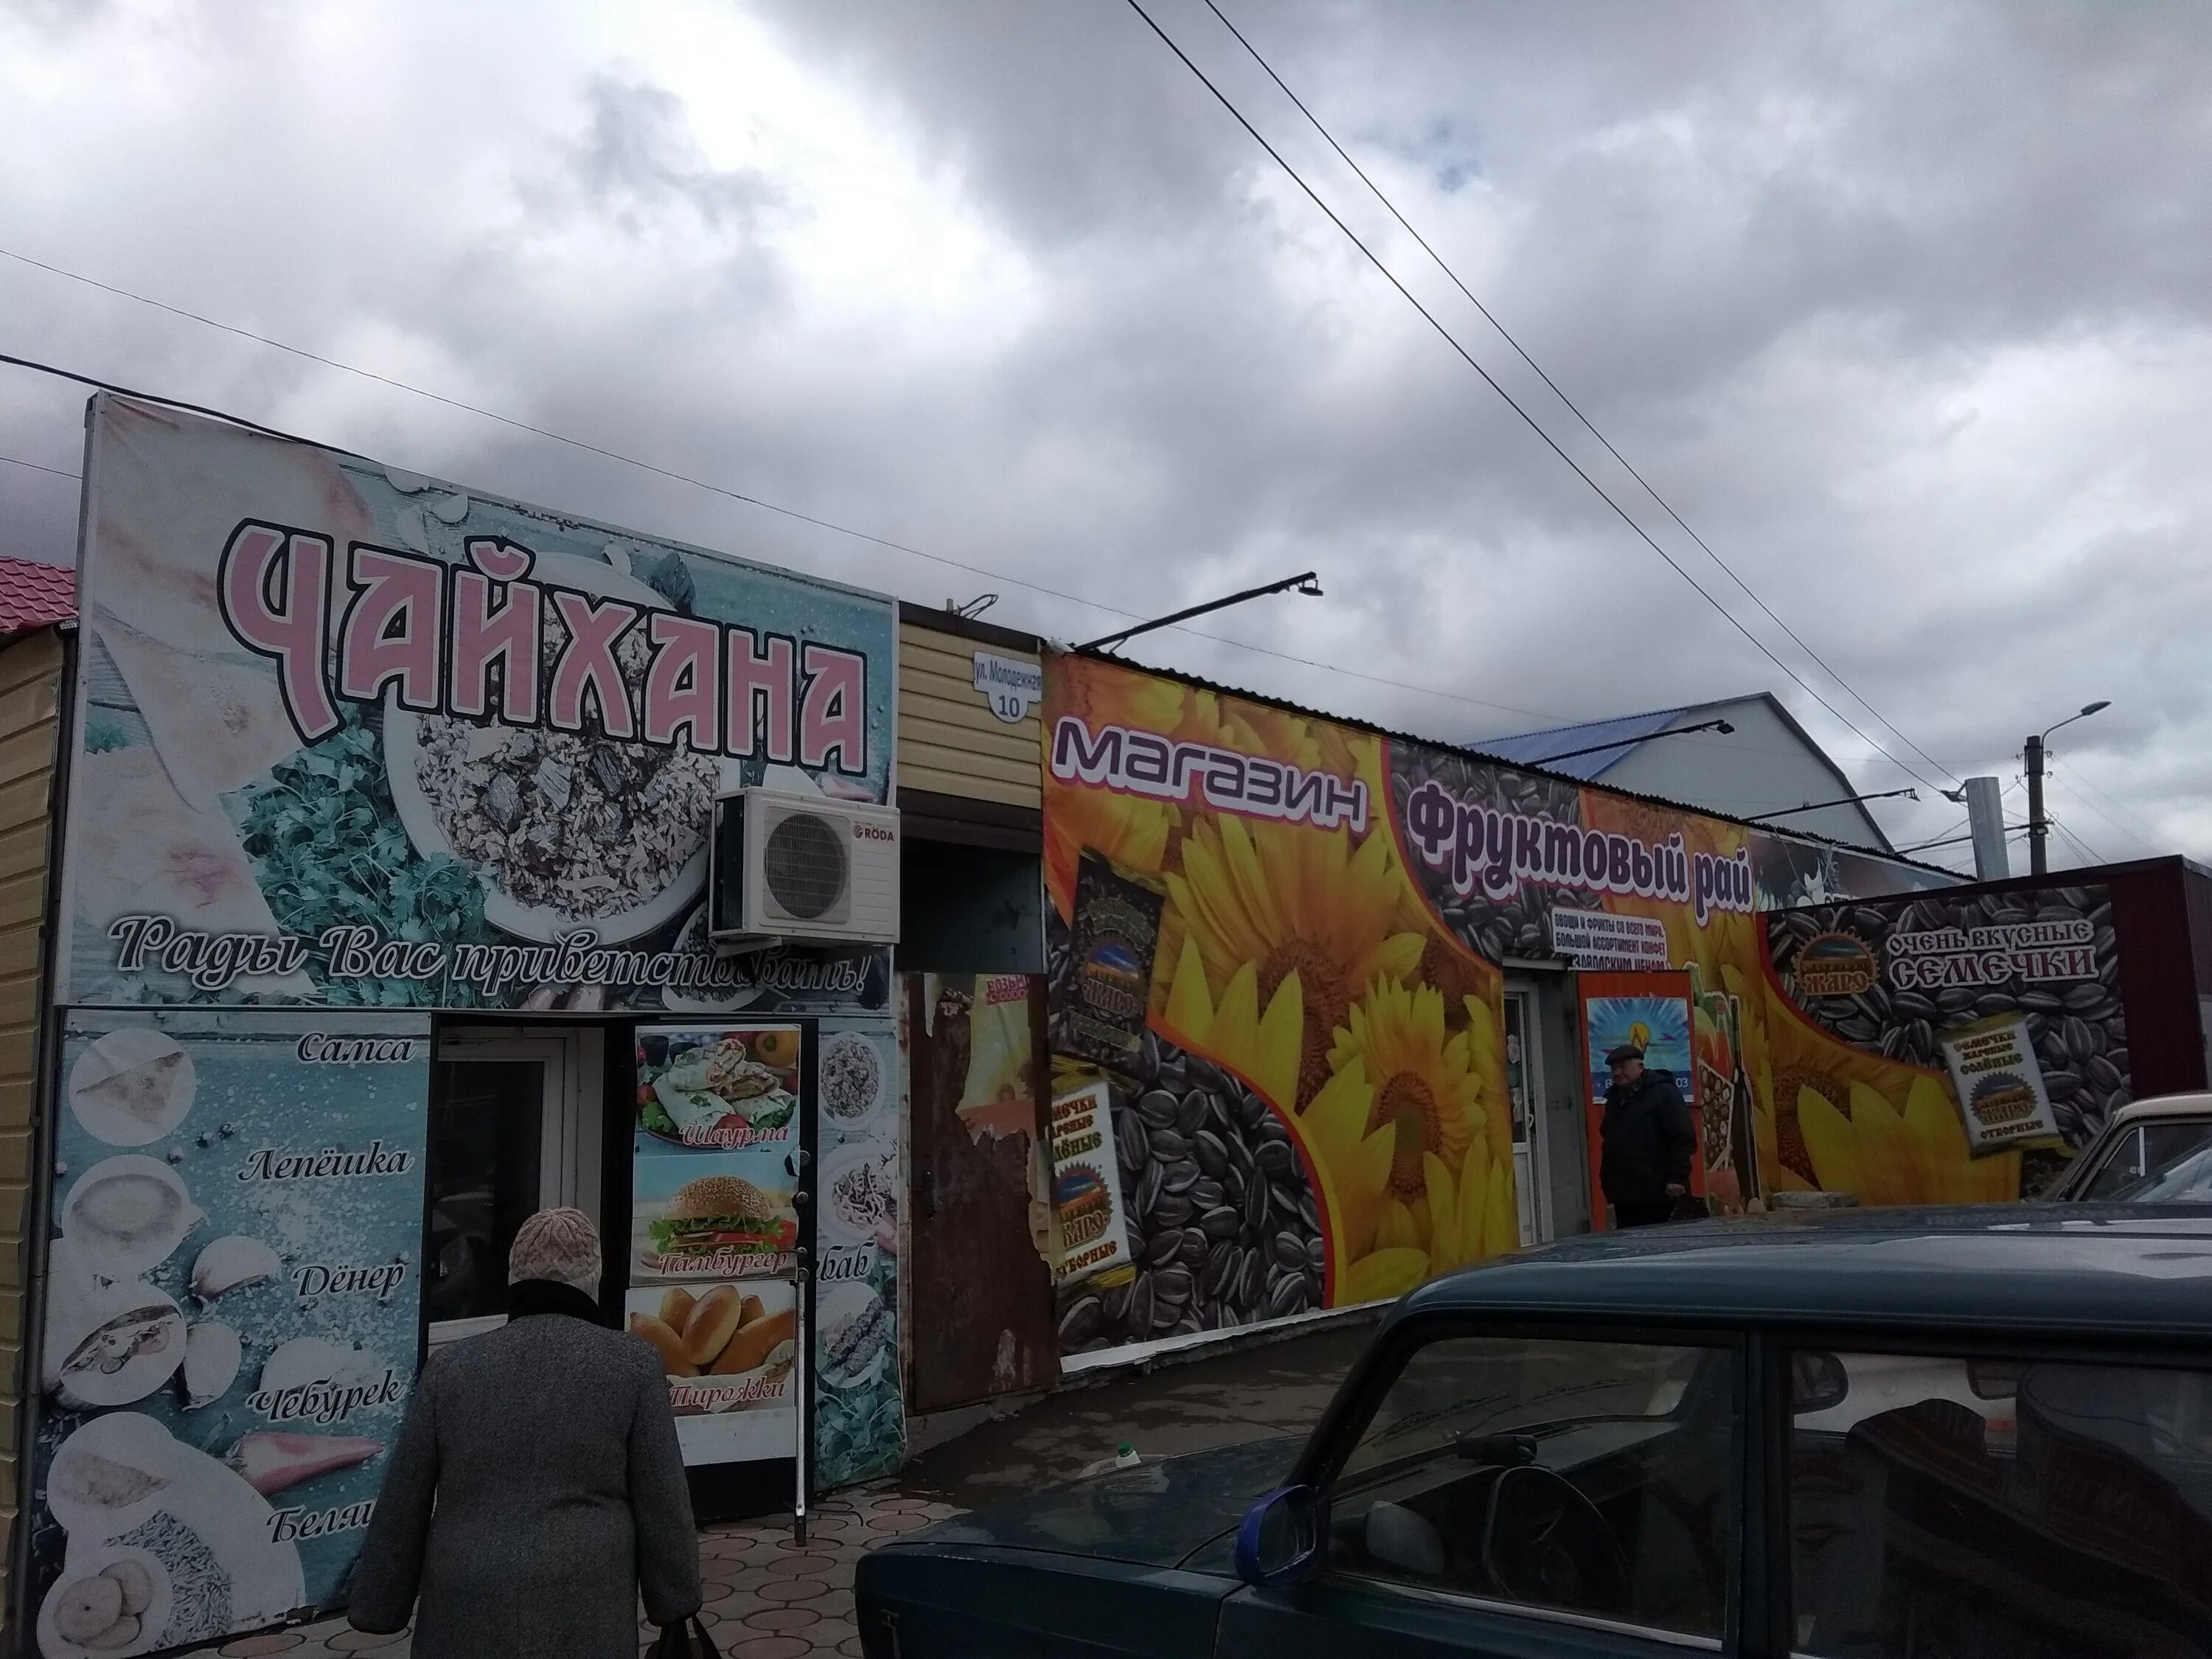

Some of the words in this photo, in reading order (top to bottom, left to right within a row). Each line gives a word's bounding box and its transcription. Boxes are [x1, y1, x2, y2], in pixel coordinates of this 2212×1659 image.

[217, 518, 867, 777] ЧАЙХАНА
[975, 661, 987, 684] ул.
[990, 659, 1041, 691] Молодежная
[998, 695, 1020, 718] 10
[1054, 718, 1365, 830] Магазин
[864, 825, 894, 842] RÖDA
[1408, 780, 1688, 904] Фруктовый
[1693, 846, 1754, 926] рай
[1554, 913, 1579, 931] ОВОЩИ
[1580, 919, 1586, 931] И
[1587, 917, 1615, 932] ФРУКТЫ
[1616, 920, 1624, 934] СО
[1626, 922, 1644, 936] ВСЕГО
[1886, 931, 1967, 956] ОЧЕНЬ
[1972, 919, 2095, 952] ВКУСНЫЕ
[108, 915, 307, 992] Рады
[319, 926, 446, 979] Вас
[1556, 932, 1591, 950] БОЛЬШОЙ
[1593, 936, 1639, 953] АССОРТИМЕНТ
[1641, 941, 1666, 956] КОНФЕТ
[1889, 946, 2098, 990] СЕМЕЧКИ
[296, 1033, 415, 1063] Самса
[1675, 1077, 1688, 1088] 03
[680, 1122, 789, 1150] Шаурма
[238, 1141, 414, 1181] Лепёшка
[658, 1248, 788, 1279] Гамбургер
[293, 1265, 406, 1300] Дёнер
[246, 1369, 403, 1424] Чебурек
[668, 1374, 787, 1412] Пирожки
